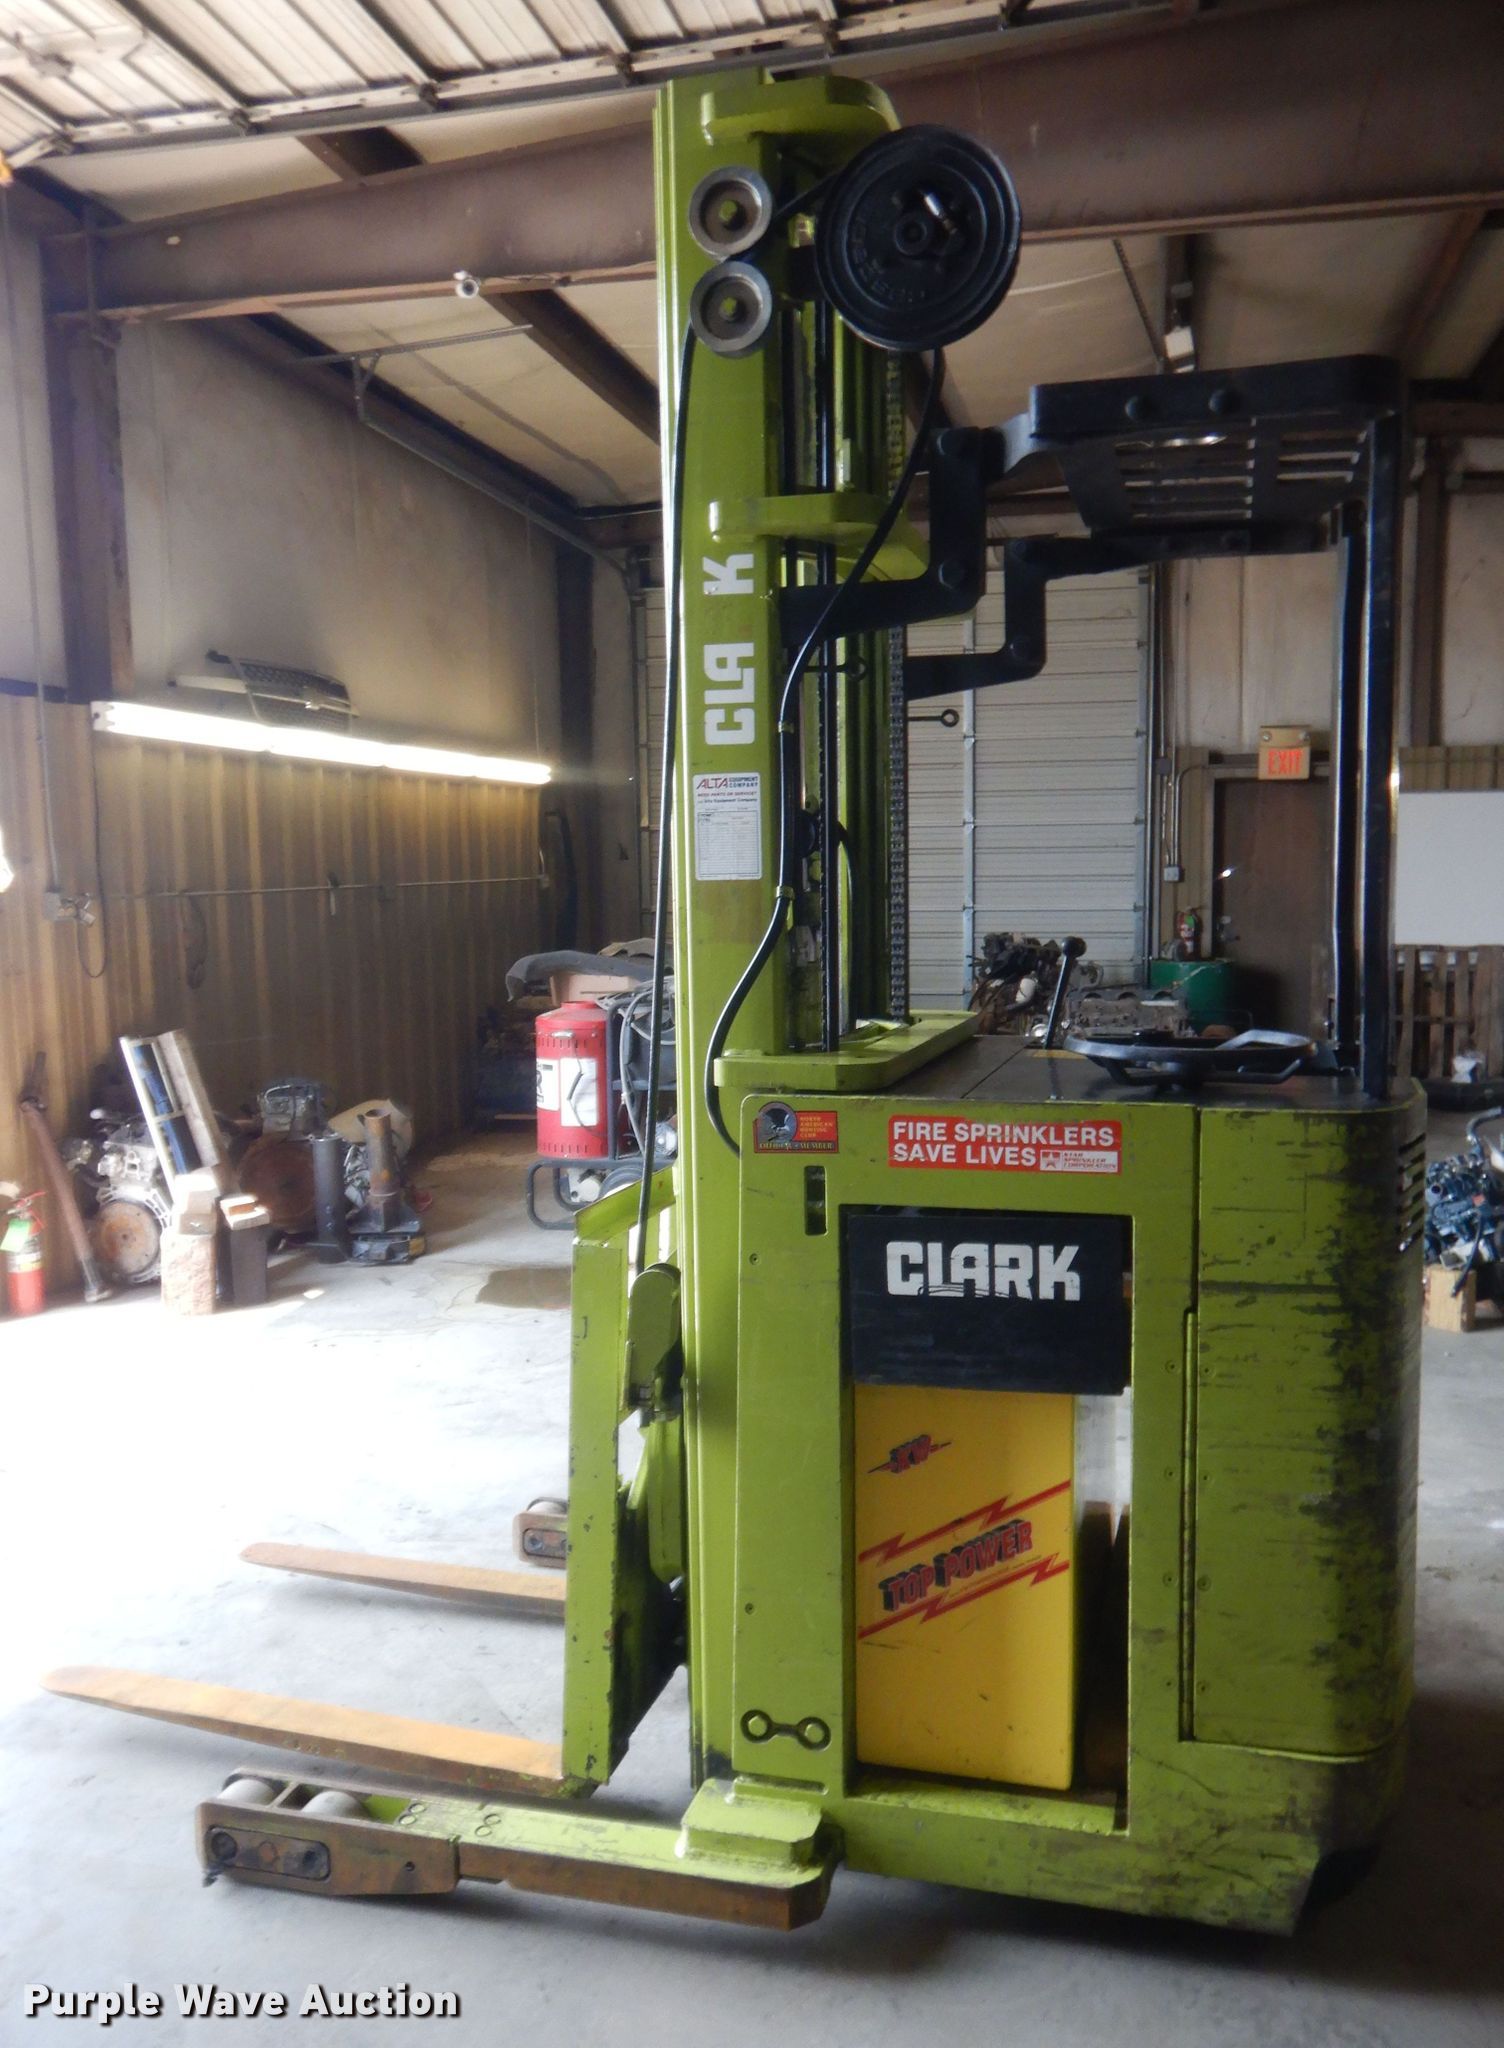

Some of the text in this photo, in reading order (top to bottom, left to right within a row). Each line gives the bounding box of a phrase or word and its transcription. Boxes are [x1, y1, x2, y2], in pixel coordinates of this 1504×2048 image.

[1268, 749, 1302, 775] EXIT
[696, 777, 728, 789] ALTA
[893, 1121, 1114, 1146] FIRE SPRINKLERS
[893, 1143, 1036, 1167] SAVE LIVES
[886, 1241, 1081, 1301] CLARK
[878, 1563, 936, 1612] TOP
[934, 1519, 1033, 1588] POWER
